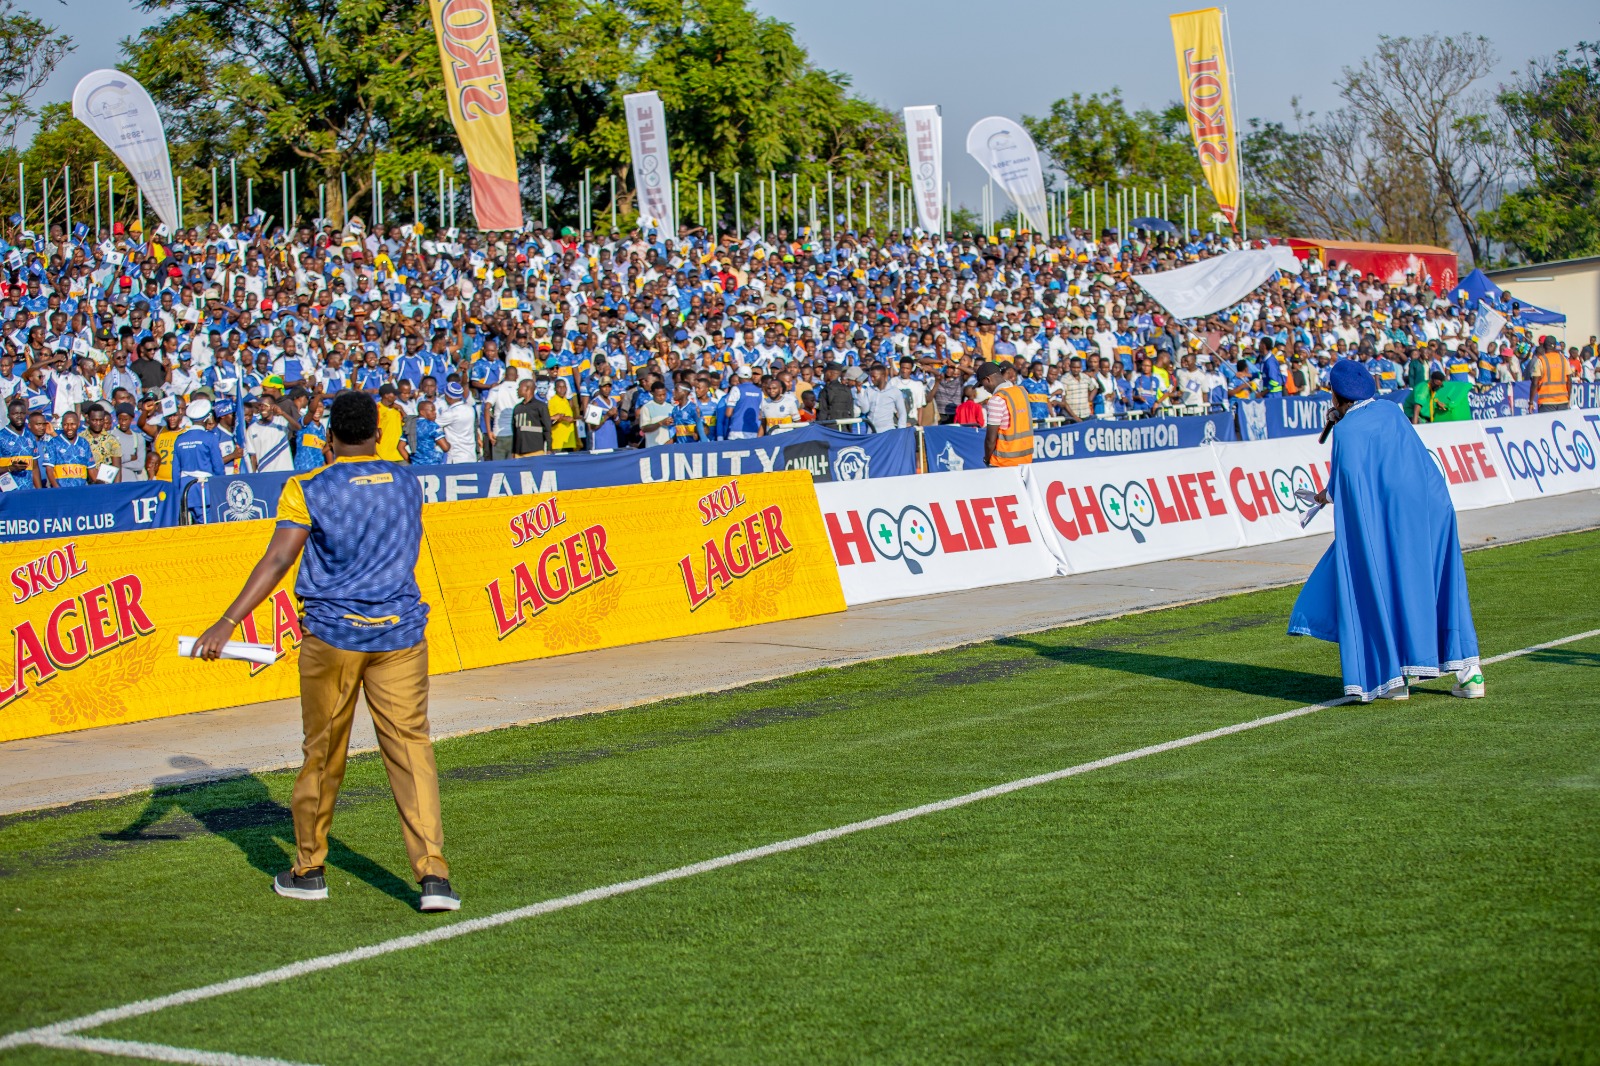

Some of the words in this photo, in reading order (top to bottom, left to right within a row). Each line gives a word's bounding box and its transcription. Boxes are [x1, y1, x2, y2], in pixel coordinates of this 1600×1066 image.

[1282, 399, 1318, 429] IJWI
[1085, 424, 1178, 453] GENERATION
[1485, 420, 1596, 493] Tap&Go
[639, 446, 781, 484] UNITY
[1426, 442, 1497, 485] LIFE
[0, 519, 39, 535] EMBO
[44, 517, 72, 533] FAN
[76, 513, 115, 531] CLUB
[509, 496, 567, 548] SKOL
[698, 479, 746, 526] SKOL
[10, 542, 87, 604] SKOL
[679, 504, 793, 612] LAGER
[486, 523, 618, 641] LAGER
